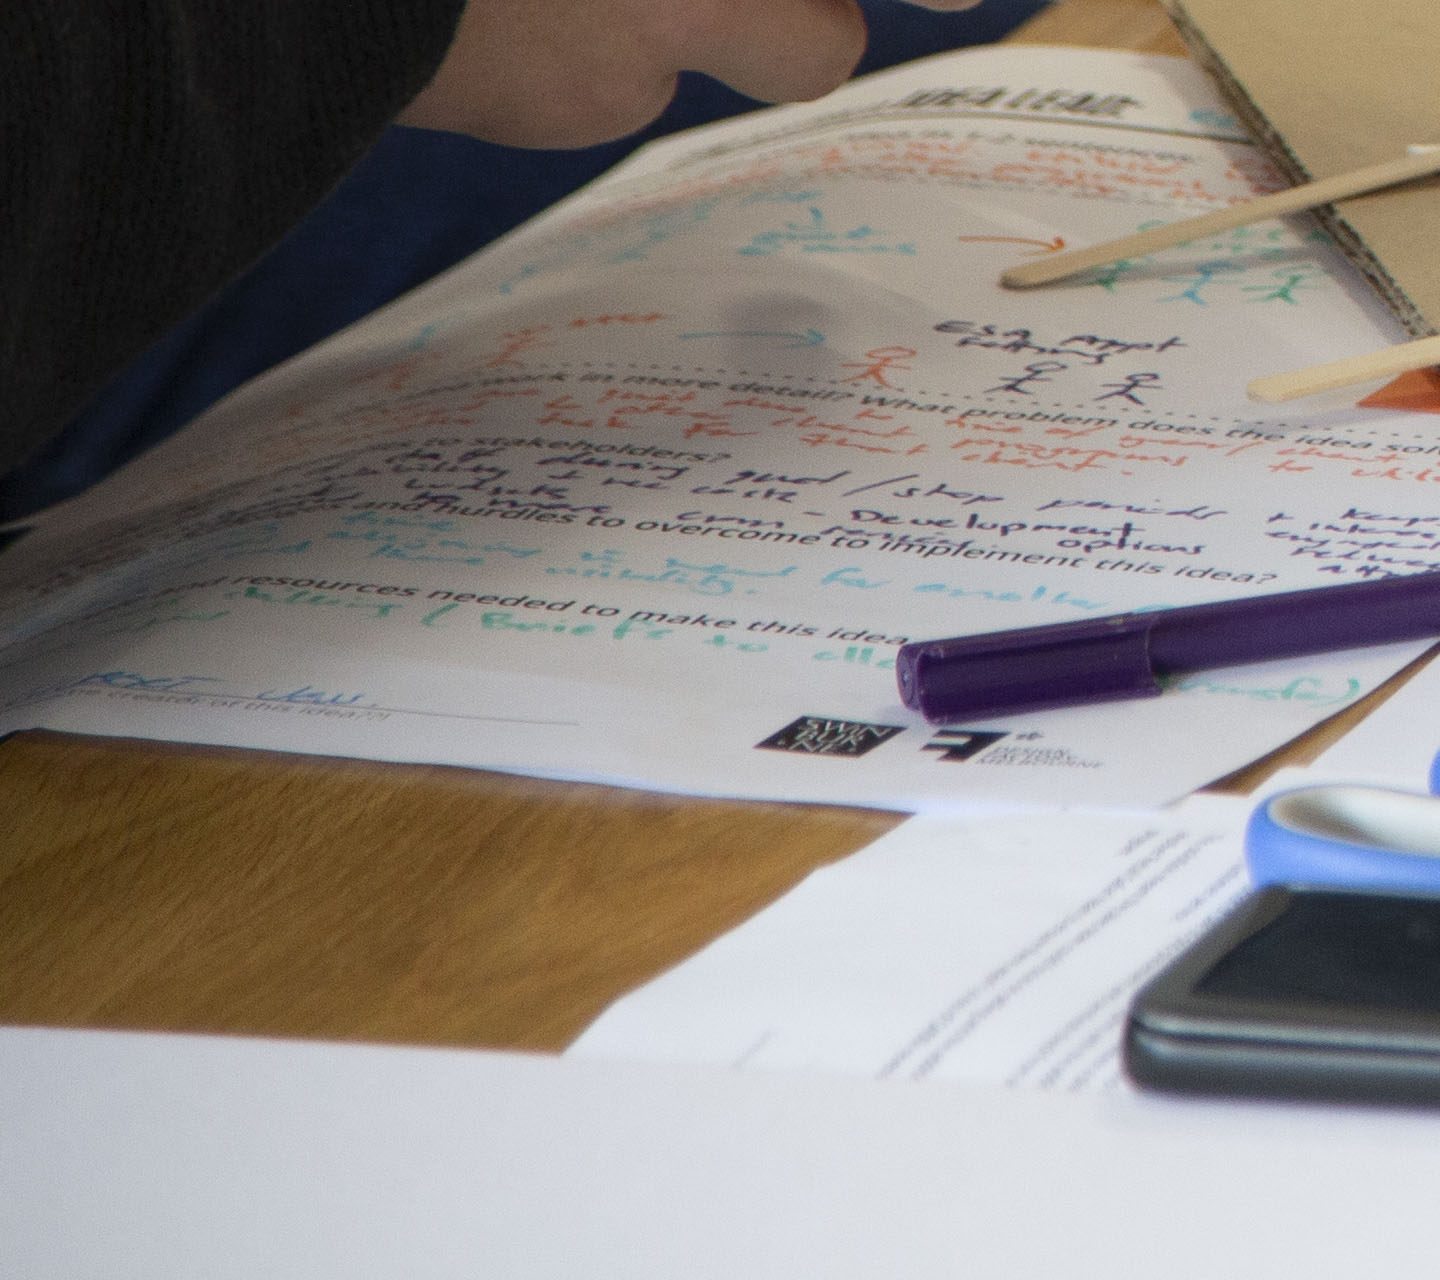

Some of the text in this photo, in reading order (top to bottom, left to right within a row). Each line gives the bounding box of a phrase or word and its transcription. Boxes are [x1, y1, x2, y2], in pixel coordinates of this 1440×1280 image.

[729, 381, 855, 402] detail?
[861, 395, 956, 414] What
[961, 406, 1118, 427] problem
[1127, 418, 1213, 436] does
[1225, 425, 1286, 440] the
[1295, 434, 1373, 449] idea
[430, 500, 578, 526] hurdles
[585, 513, 626, 528] to
[634, 520, 822, 546] overcome
[830, 533, 871, 550] to
[879, 536, 1088, 570] implement
[1095, 558, 1167, 576] this
[1174, 565, 1279, 585] idea?
[1056, 532, 1209, 556] options
[231, 573, 420, 598] resources
[427, 589, 576, 613] needed
[581, 603, 620, 618] to
[628, 608, 738, 630] make
[747, 620, 819, 639] this
[826, 626, 910, 646] idea
